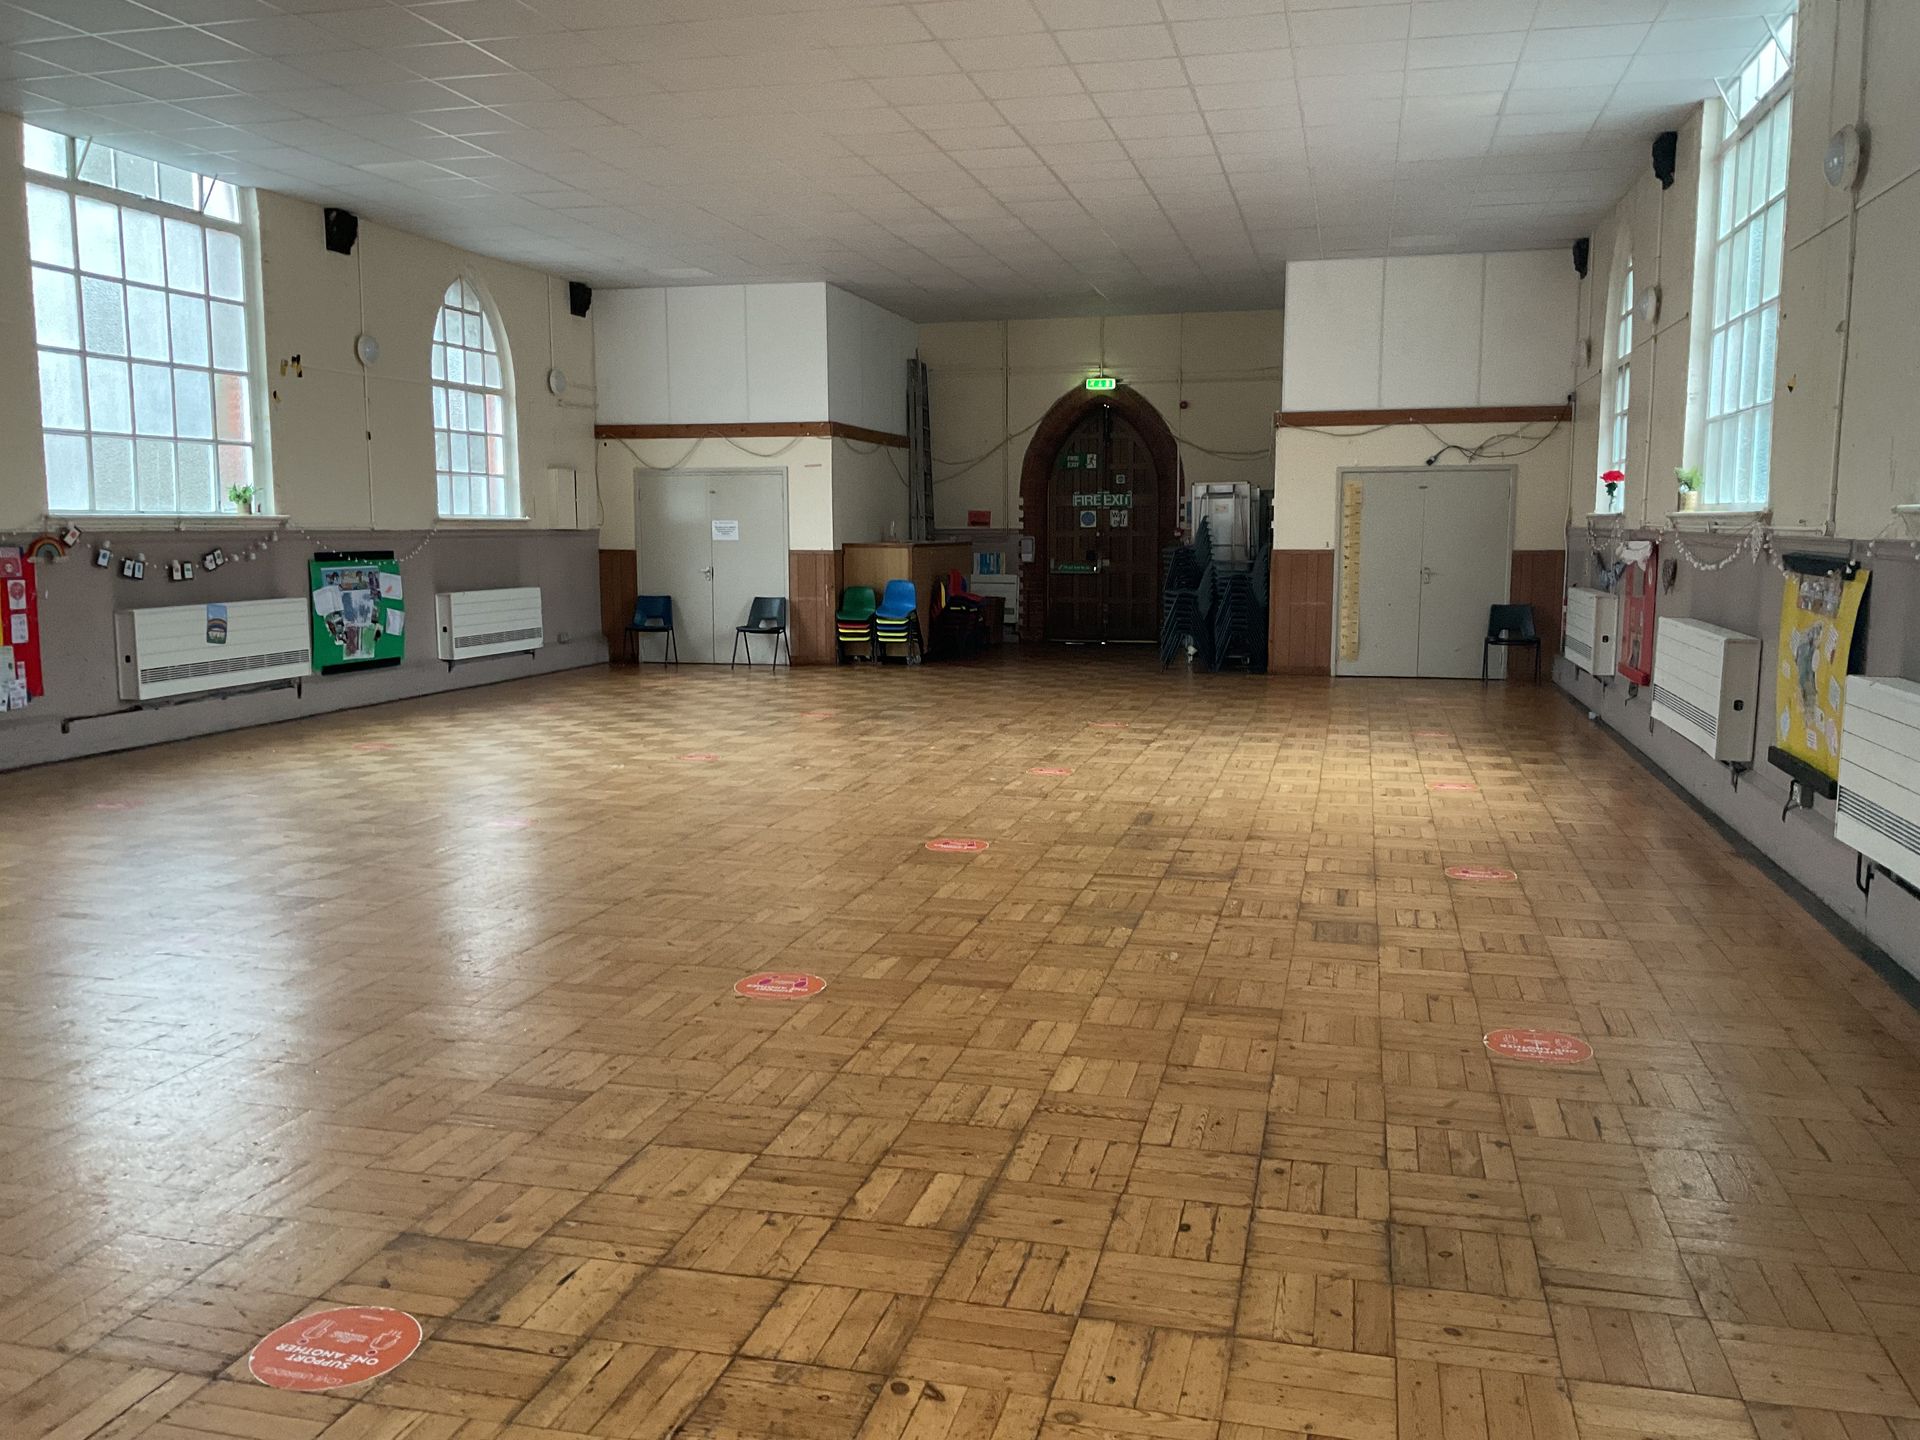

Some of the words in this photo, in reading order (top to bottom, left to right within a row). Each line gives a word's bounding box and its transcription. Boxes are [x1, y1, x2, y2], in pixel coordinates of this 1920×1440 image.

[1074, 494, 1101, 506] FIRE
[1103, 493, 1131, 506] EXIT
[276, 1342, 347, 1360] ANOTHER
[285, 1353, 348, 1370] SUPPORT
[350, 1353, 379, 1366] ONE
